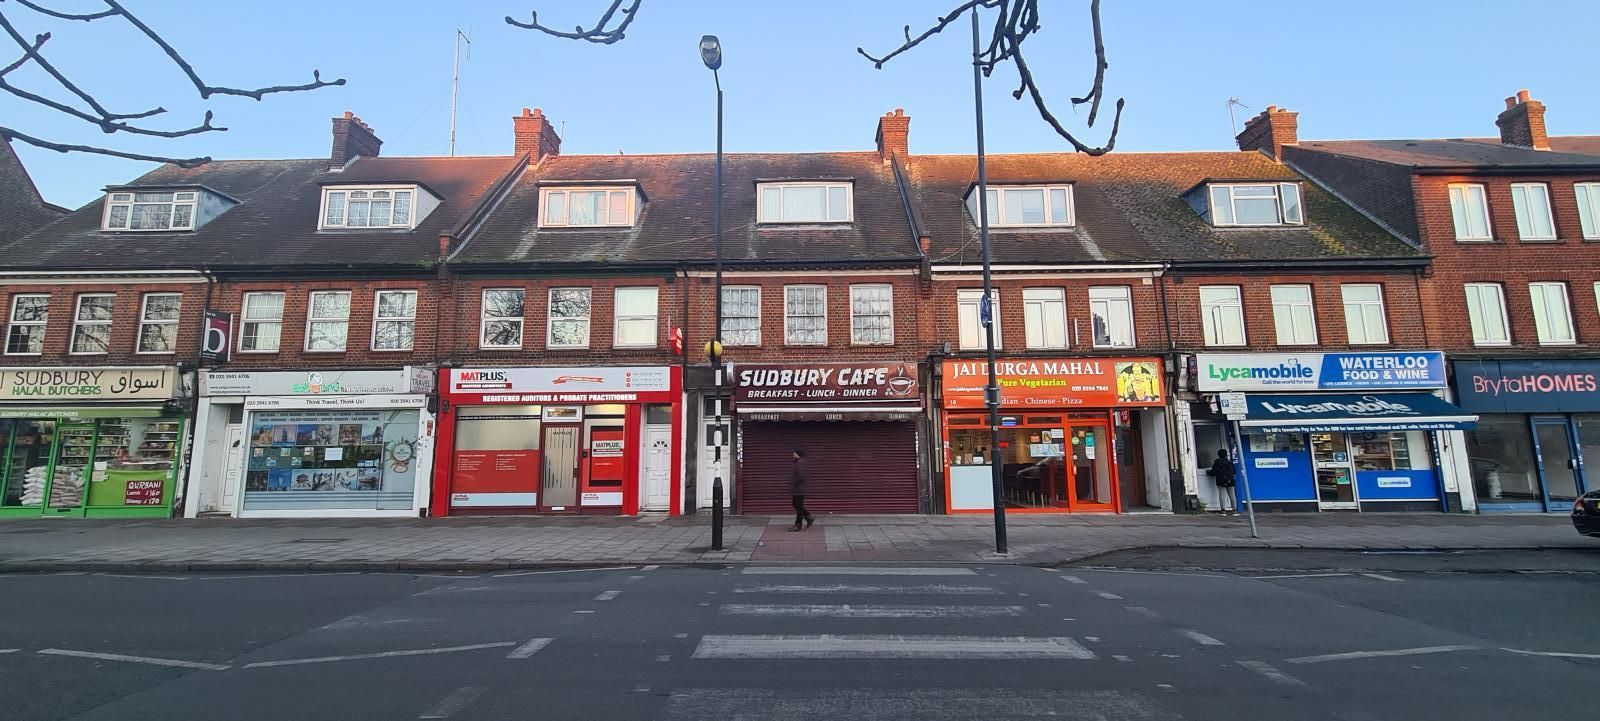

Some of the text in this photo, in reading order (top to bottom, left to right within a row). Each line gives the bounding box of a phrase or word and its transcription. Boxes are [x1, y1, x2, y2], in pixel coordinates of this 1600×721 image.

[203, 318, 225, 353] b
[953, 362, 1104, 378] JAI DURGA MAHAL
[1208, 359, 1313, 381] Lycamobile
[1339, 356, 1428, 370] WATERLOO
[13, 370, 104, 386] SUDBURY
[460, 372, 504, 381] MATPLUS
[740, 367, 889, 387] SUDBURY CAFE
[1343, 369, 1429, 380] FOOD & WINE
[12, 385, 102, 396] HALAL BUTCHERS
[997, 378, 1067, 389] Pure Vegetarian
[1473, 374, 1597, 396] BrytaHOMES
[748, 389, 799, 398] BREAKFAST
[807, 389, 836, 398] LUNCH
[843, 388, 878, 397] DINNER
[1025, 397, 1056, 405] Chinese
[1063, 397, 1083, 405] Pizza
[1261, 398, 1412, 414] Lycamobile
